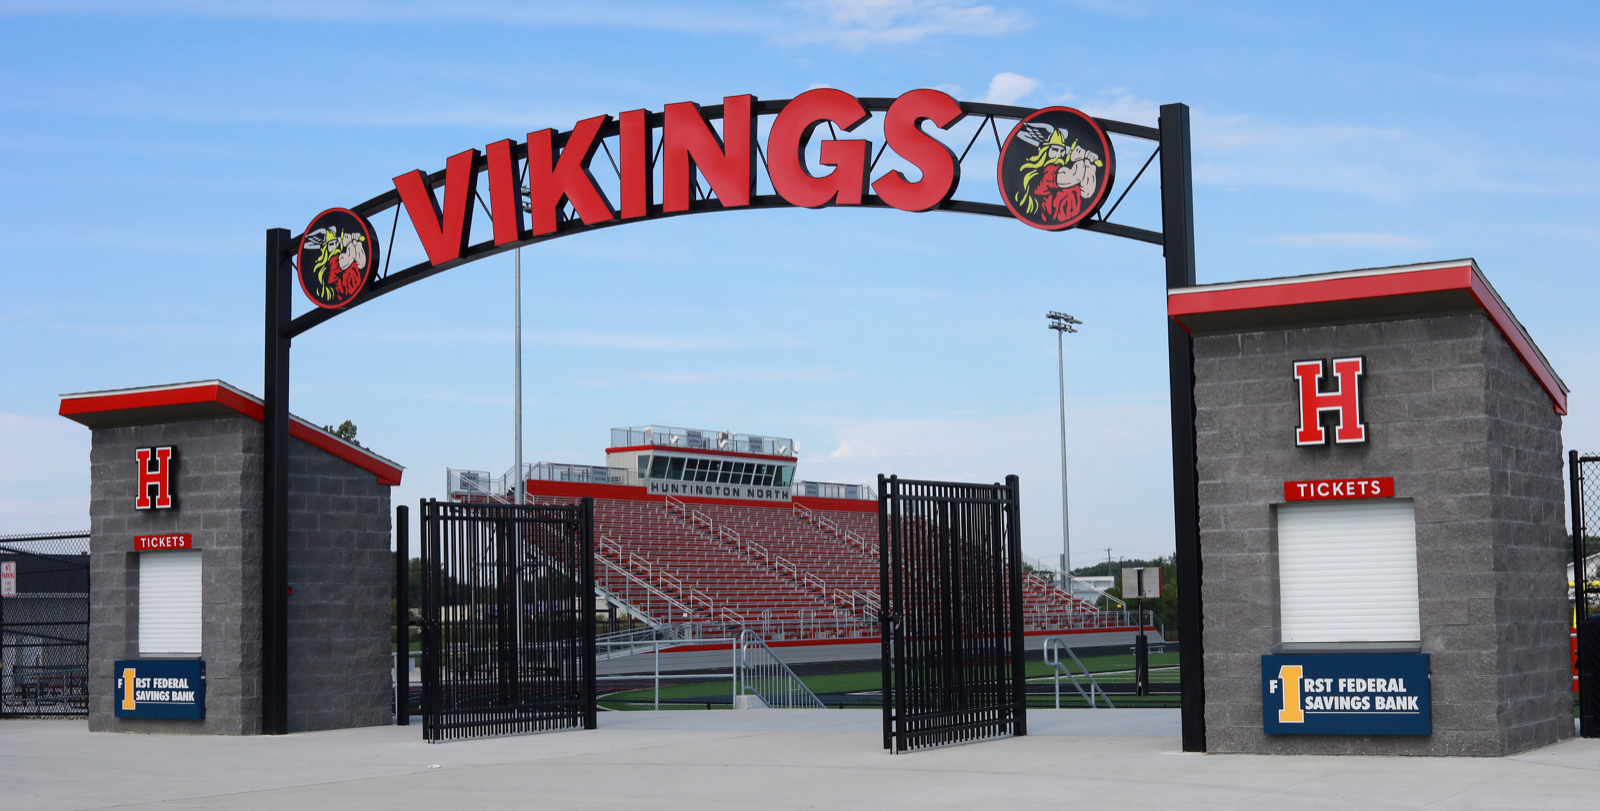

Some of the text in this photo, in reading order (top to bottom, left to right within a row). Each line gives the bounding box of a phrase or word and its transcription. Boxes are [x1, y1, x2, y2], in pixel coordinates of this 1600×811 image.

[392, 88, 968, 266] VIKINGS
[1292, 355, 1368, 447] H
[135, 446, 176, 510] H
[651, 482, 789, 500] HUNTINGTON NORTH
[1296, 480, 1381, 497] TICKETS
[140, 536, 185, 548] TICKETS
[153, 678, 189, 688] FEDERAL
[1338, 678, 1407, 693] FEDERAL
[136, 690, 195, 702] SAVINGS BANK
[1304, 696, 1420, 710] SAVINGS BANK
